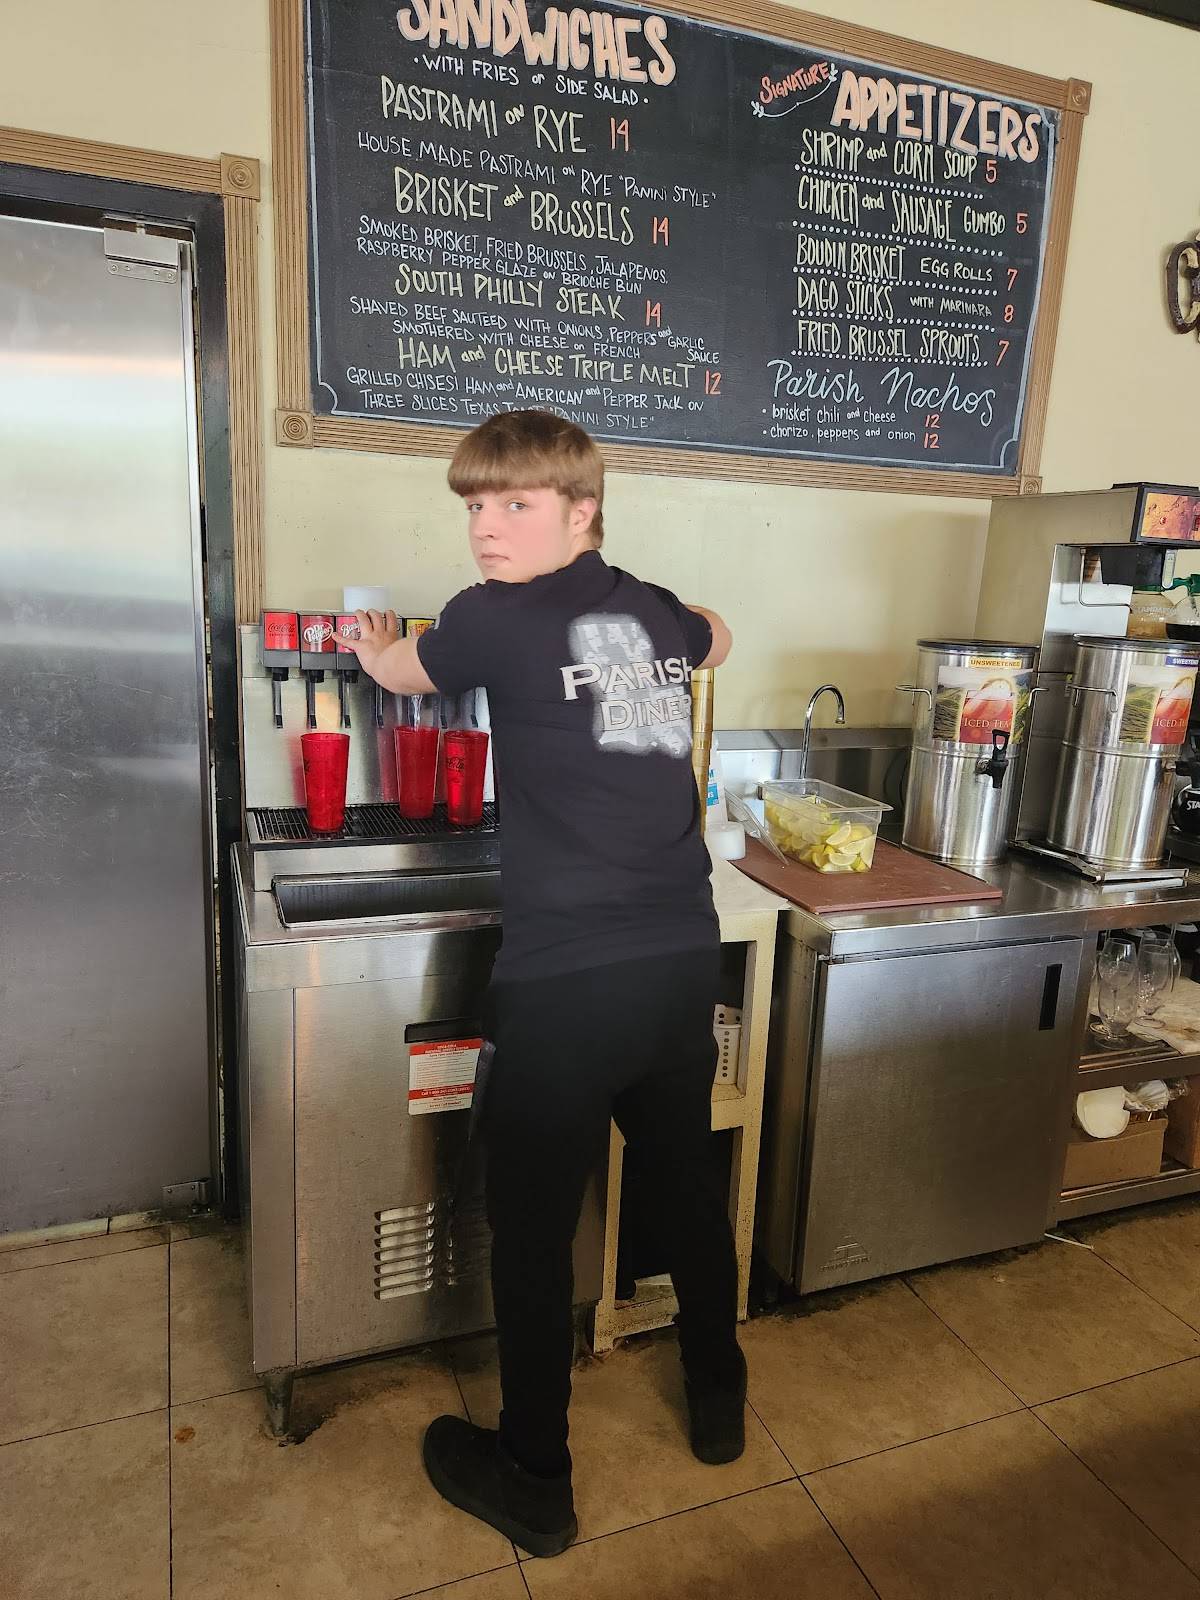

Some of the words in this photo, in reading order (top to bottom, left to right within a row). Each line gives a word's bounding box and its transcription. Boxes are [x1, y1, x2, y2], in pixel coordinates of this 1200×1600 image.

[396, 0, 676, 86] SANDWICHES
[421, 54, 464, 76] WITH
[472, 60, 520, 85] FRIES
[555, 74, 588, 95] SIDE
[759, 60, 830, 104] SIGNATURE
[380, 74, 498, 139] PASTRAMI
[533, 104, 587, 154] RYE
[609, 116, 630, 153] 14
[829, 69, 1042, 163] APPETIZERS
[358, 131, 412, 158] HOUSE
[418, 139, 473, 169] MADE
[479, 149, 556, 185] PASTRAMI
[580, 168, 612, 198] RYE
[800, 128, 865, 172] SHRIMP
[866, 141, 888, 162] and
[893, 139, 934, 184] CORN
[944, 149, 977, 183] SOUP
[984, 159, 998, 183] 5
[393, 166, 499, 221] BRISKET
[503, 183, 525, 207] and
[651, 215, 670, 247] 14
[798, 174, 859, 228] CHICKEN
[861, 190, 885, 211] and
[891, 189, 957, 243] SAUSAGE
[963, 204, 1006, 237] GUMBO
[1015, 212, 1028, 234] 5
[359, 214, 419, 243] SMOKED
[486, 236, 524, 262] FRIED
[796, 233, 847, 272] BOUDIN
[850, 242, 906, 282] BRISKET
[919, 256, 950, 278] EGG
[953, 262, 993, 282] ROLLS
[1006, 267, 1019, 291] 7
[357, 237, 434, 265] RASPBERRY
[442, 250, 491, 272] PEPPER
[495, 259, 537, 279] GLAZE
[561, 270, 611, 291] BRIOCHE
[615, 278, 643, 295] BUN
[395, 263, 463, 298] SOUTH
[473, 273, 543, 308] PHILLY
[556, 286, 625, 321] STEAK
[645, 300, 662, 328] 14
[797, 276, 839, 312] DAGO
[845, 280, 895, 321] STICKS
[909, 295, 935, 309] WITH
[939, 298, 992, 318] MARINARA
[1003, 304, 1015, 324] 8
[350, 296, 408, 318] SHAVED
[414, 302, 447, 321] BEEF
[453, 307, 508, 330] SAUTEED
[513, 316, 551, 334] WITH
[657, 326, 673, 340] and
[668, 334, 705, 351] GARLIC
[392, 318, 475, 342] SMOTHERED
[478, 331, 514, 347] WITH
[519, 332, 570, 351] CHEESE
[592, 342, 641, 360] FRENCH
[797, 319, 842, 354] FRIED
[849, 324, 911, 358] BRUSSEL
[919, 328, 980, 363] SPROUTS
[997, 339, 1010, 367] 7
[398, 337, 456, 373] HAM
[460, 344, 487, 363] and
[494, 347, 565, 377] CHEESE
[569, 353, 633, 383] TRIPLE
[639, 362, 696, 389] MELT
[704, 369, 722, 396] 12
[686, 348, 720, 365] SAUCE
[346, 366, 402, 388] GRILLED
[405, 373, 459, 392] CHISESI
[464, 377, 499, 397] HAM
[497, 379, 514, 392] and
[515, 385, 583, 406] AMERICAN
[585, 384, 601, 396] and
[602, 387, 649, 410] PEPPER
[654, 393, 684, 411] JACK
[688, 399, 704, 413] ON
[360, 388, 405, 410] THREE
[411, 393, 458, 413] SLICES
[460, 398, 501, 417] TEXAS
[766, 359, 864, 404] Parish
[879, 366, 996, 427] Nachos
[771, 402, 811, 423] brisket
[816, 405, 841, 424] chili
[847, 408, 861, 419] and
[863, 410, 896, 425] cheese
[924, 413, 941, 429] 12
[816, 427, 860, 443] peppers
[865, 426, 881, 438] and
[887, 429, 916, 443] onion
[923, 433, 940, 450] 12
[970, 659, 1020, 667] UNSWEETENED
[600, 693, 692, 731] DINER
[964, 717, 990, 727] ICED
